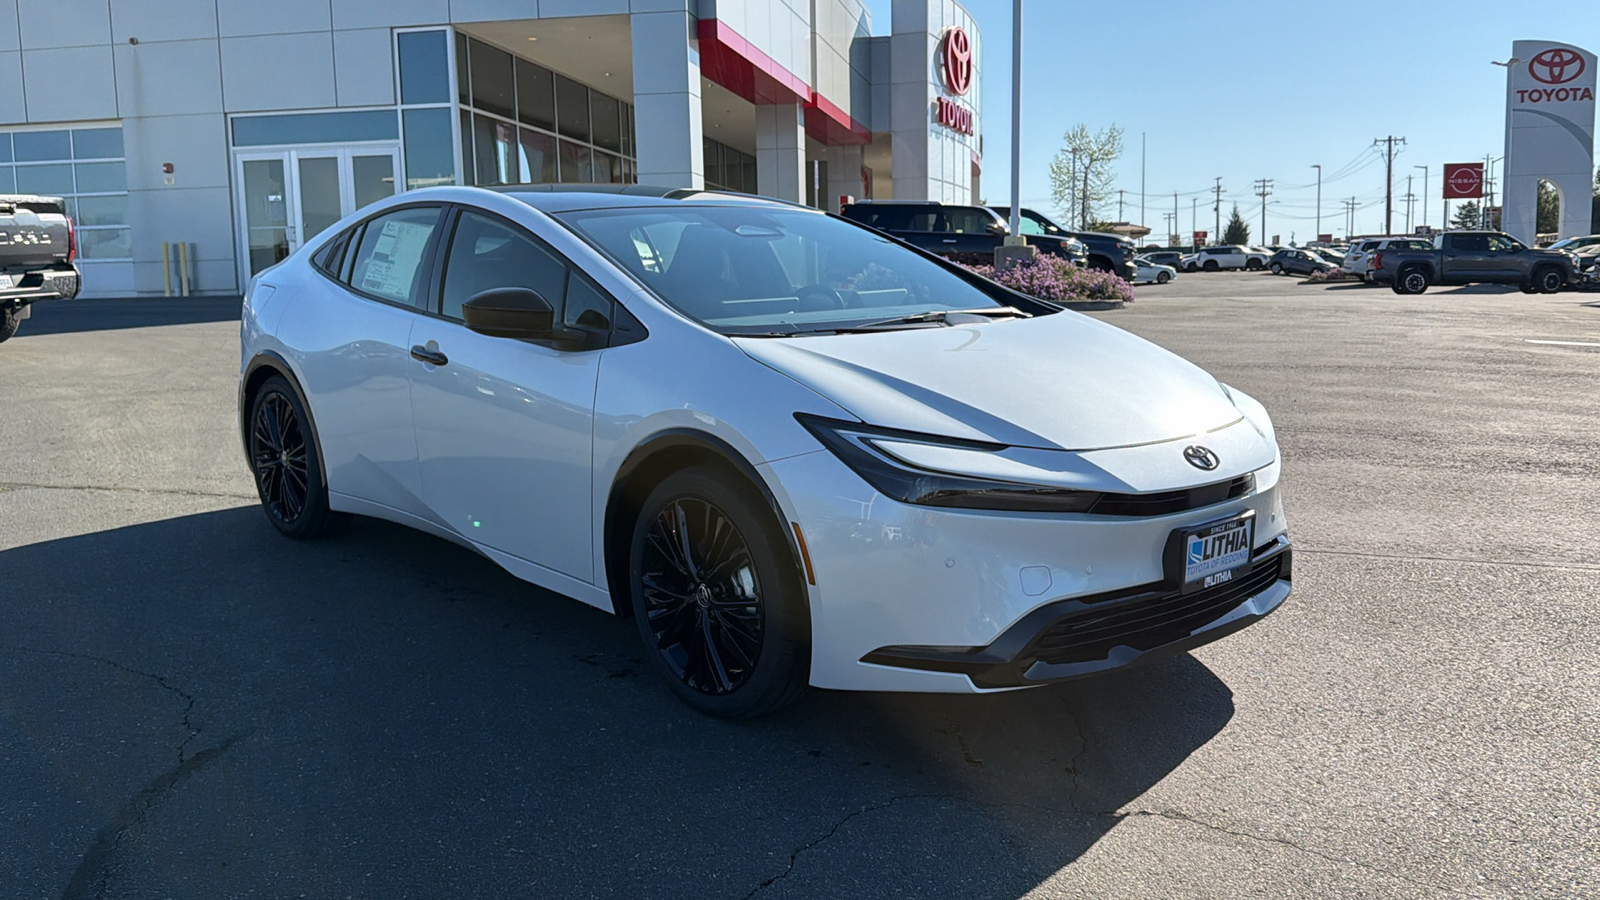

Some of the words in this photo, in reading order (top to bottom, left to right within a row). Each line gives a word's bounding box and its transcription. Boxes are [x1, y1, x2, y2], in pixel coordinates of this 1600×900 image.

[1517, 87, 1594, 103] TOYOTA
[938, 97, 974, 137] TOYOTA
[1210, 524, 1226, 535] SINCE
[1203, 527, 1248, 560] LITHIA
[1187, 561, 1210, 576] TOYOTA
[1211, 558, 1220, 569] OF
[1221, 550, 1248, 565] REDDING
[1209, 570, 1232, 586] LITHIA
